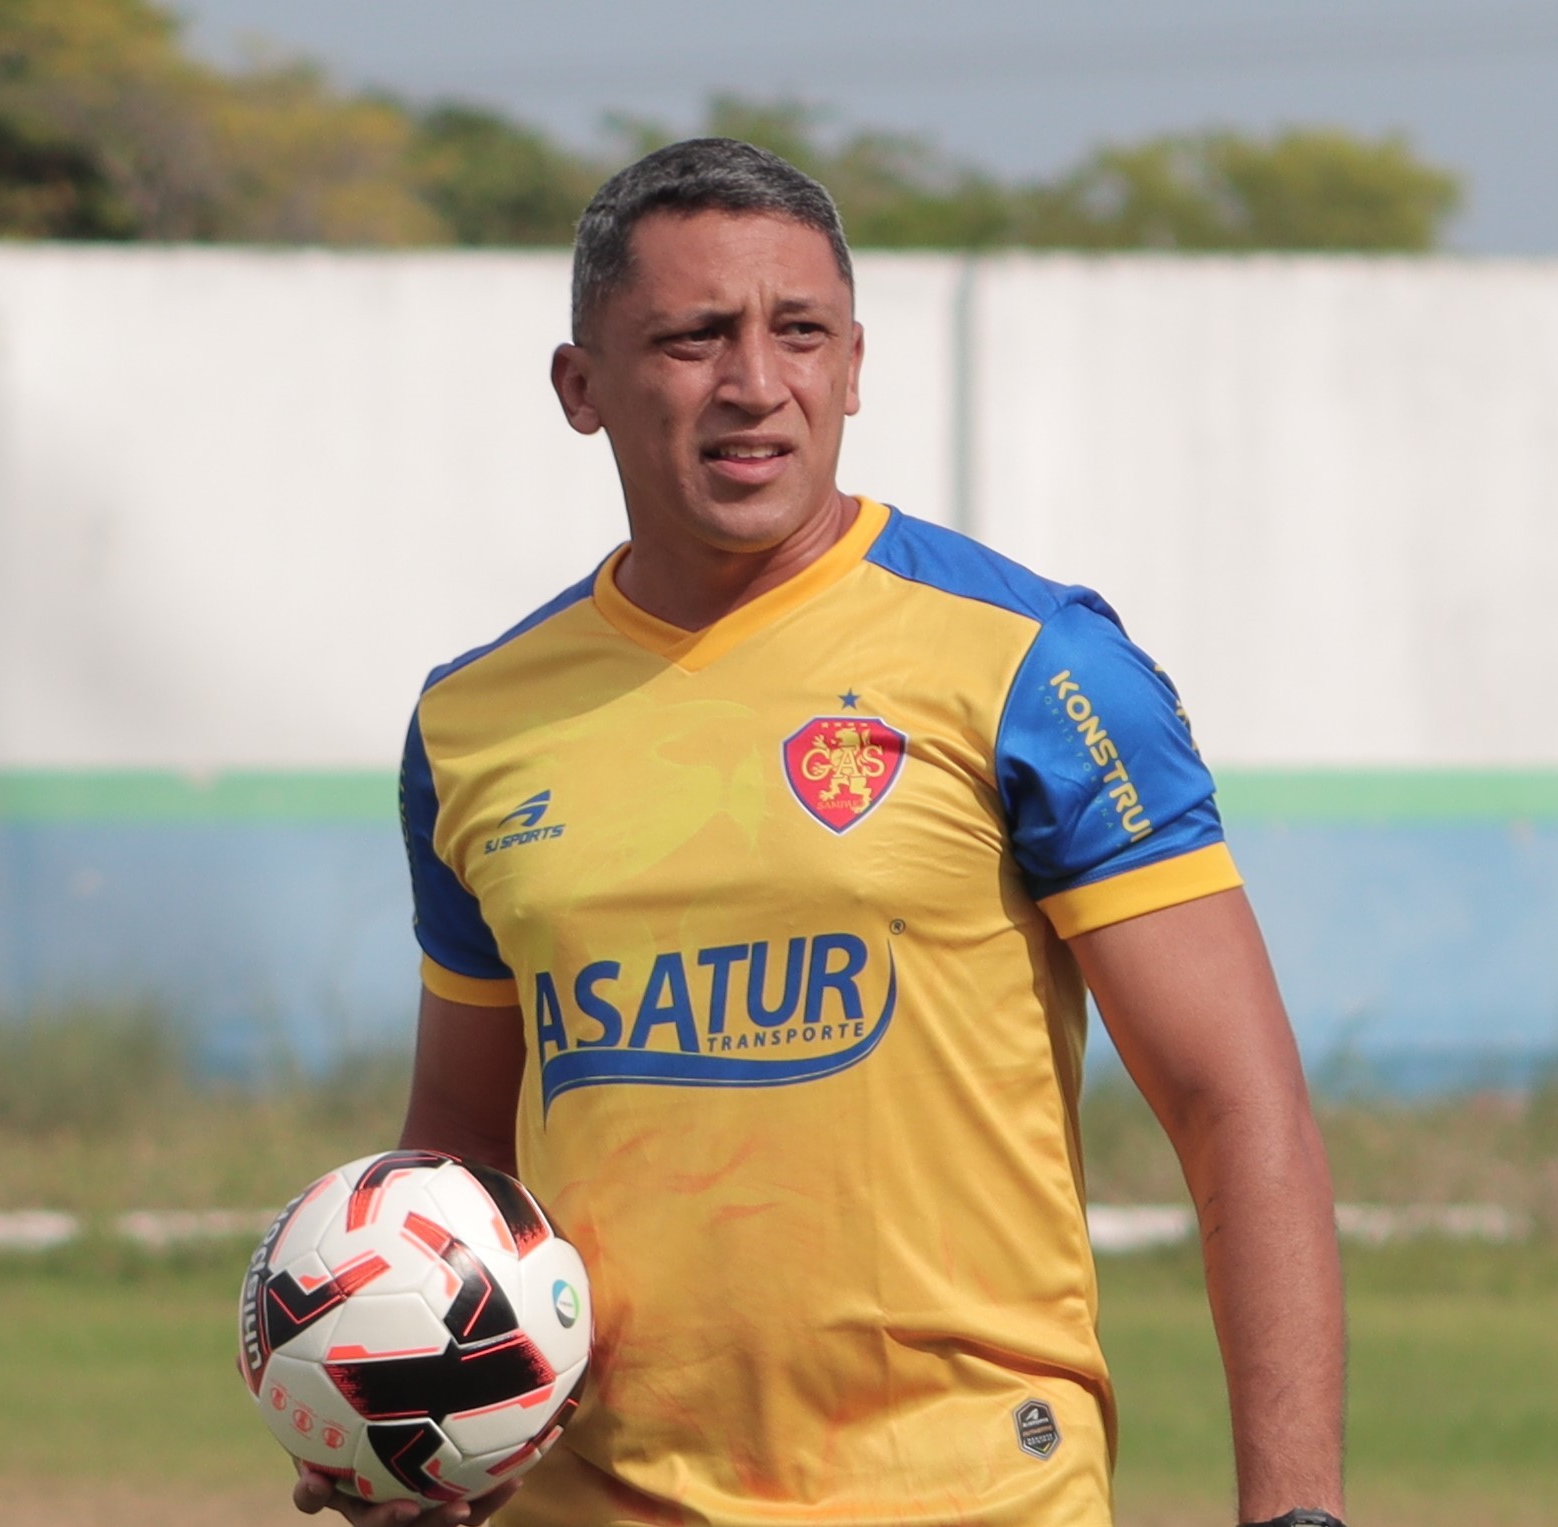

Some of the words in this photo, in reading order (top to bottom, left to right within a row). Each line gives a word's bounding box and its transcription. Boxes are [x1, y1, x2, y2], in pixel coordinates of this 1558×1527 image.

[801, 744, 885, 781] GAS
[500, 824, 566, 850] SPORTS
[535, 933, 868, 1054] ASATUR
[707, 1022, 865, 1053] TRANSPORTE
